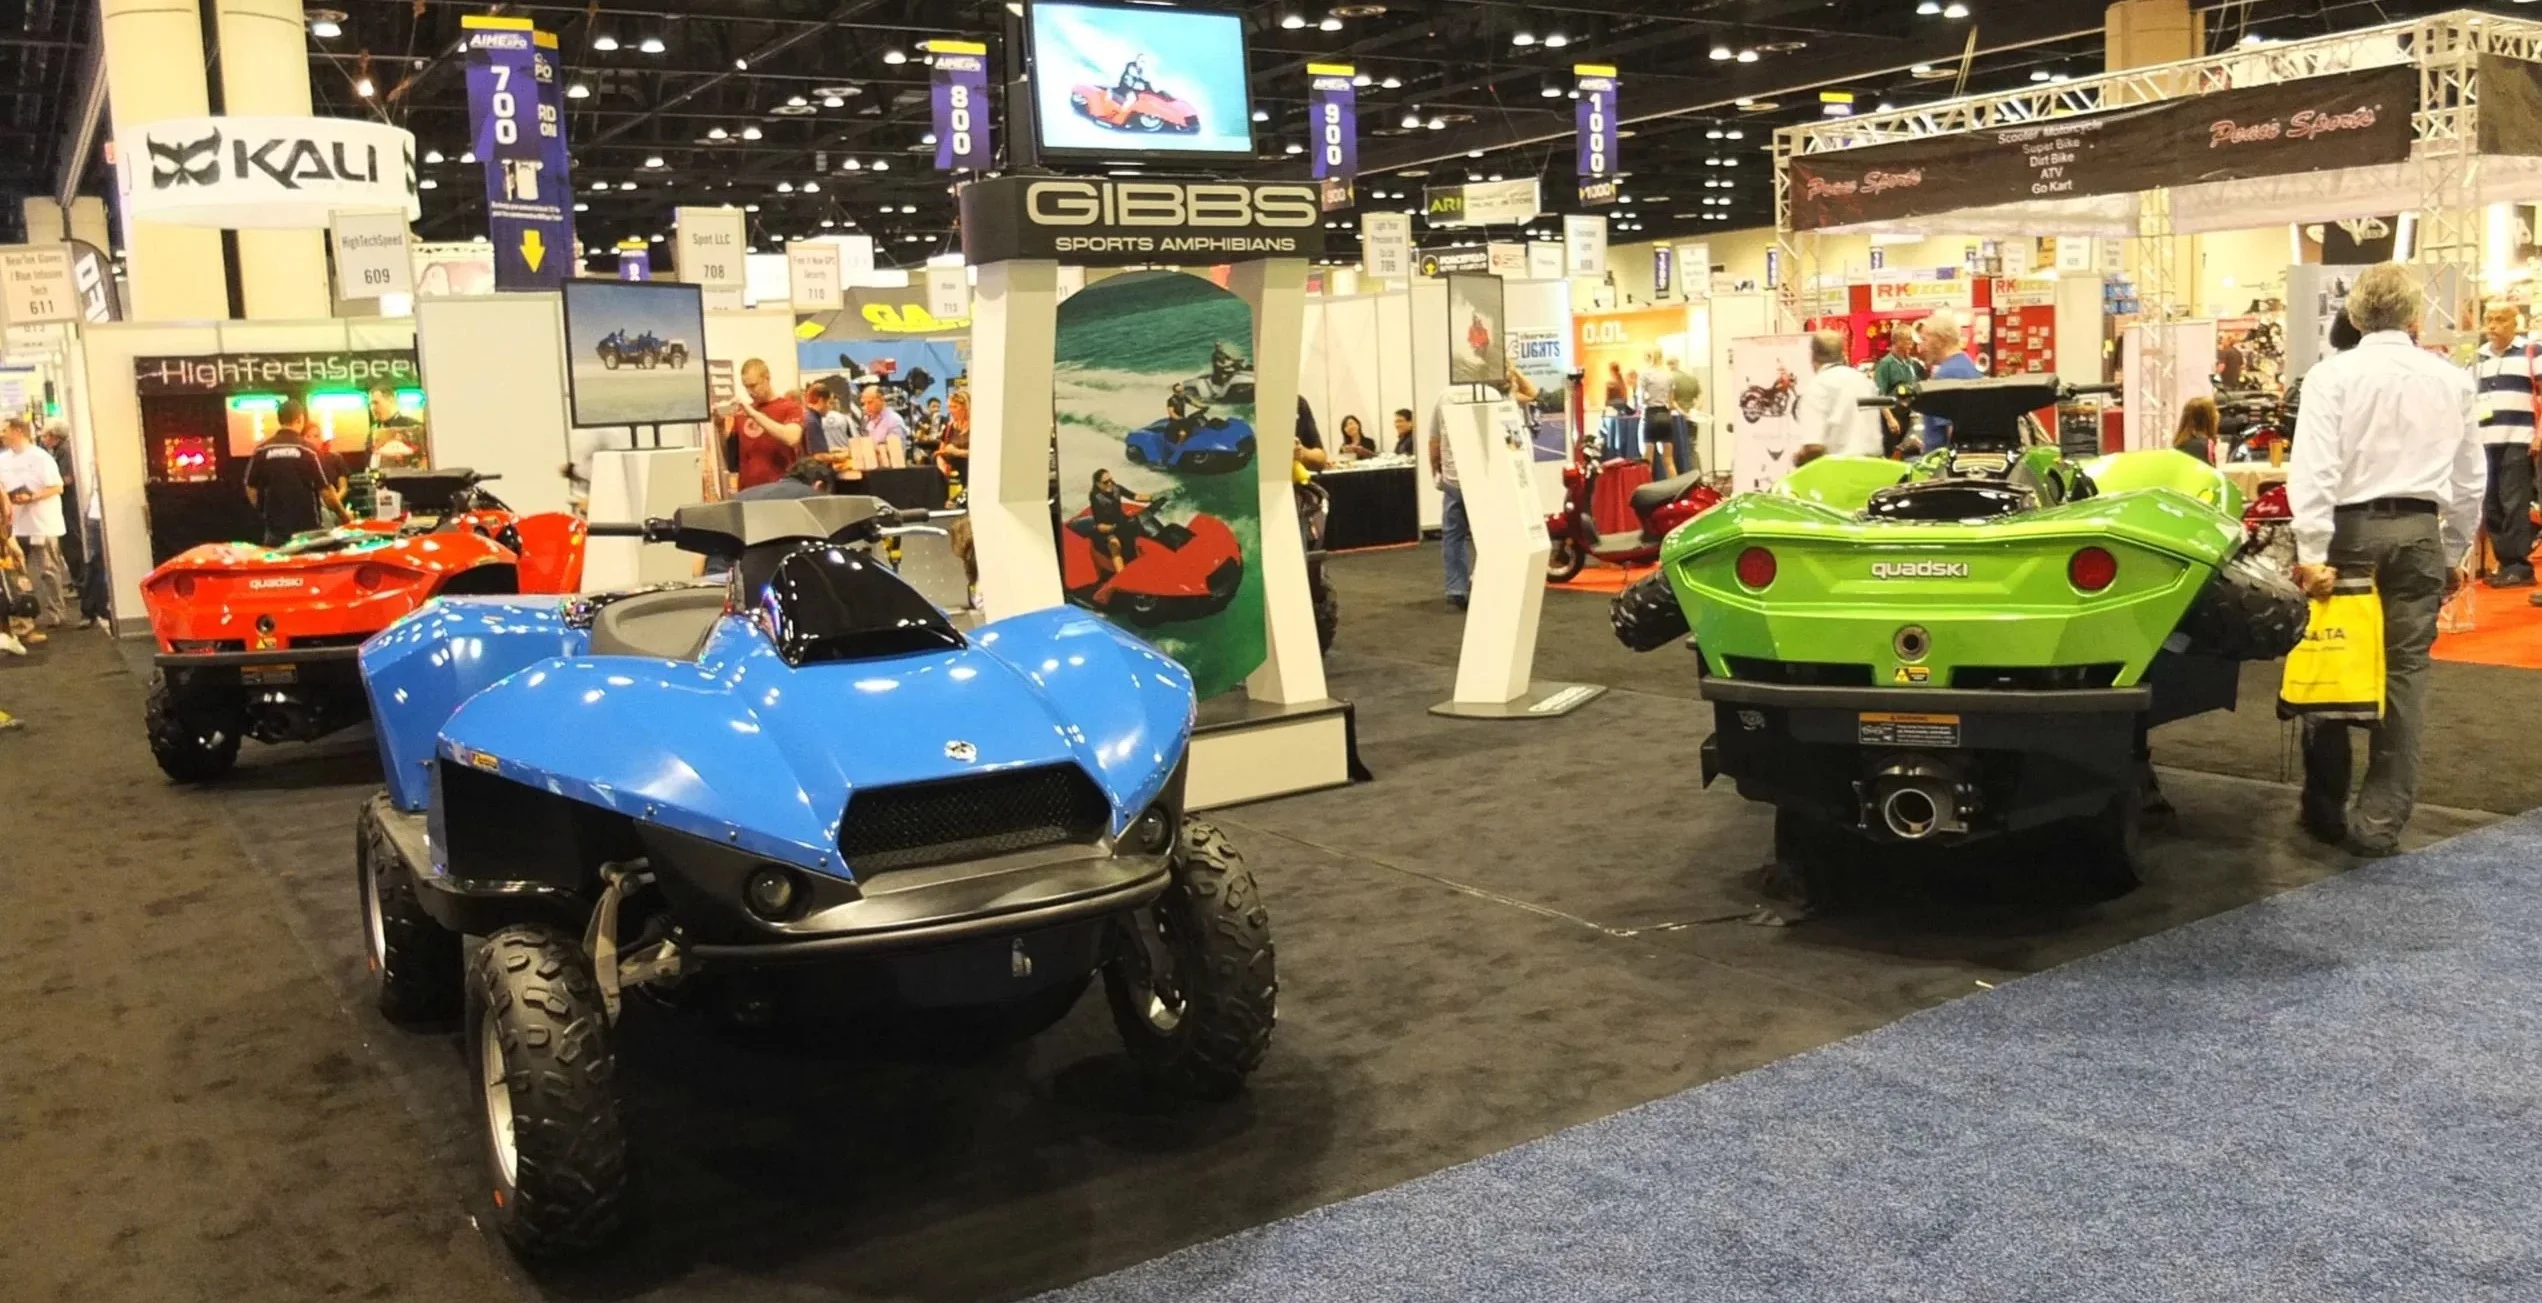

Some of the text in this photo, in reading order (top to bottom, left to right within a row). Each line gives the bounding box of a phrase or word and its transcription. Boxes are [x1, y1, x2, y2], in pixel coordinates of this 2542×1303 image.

[490, 65, 517, 145] 700
[951, 85, 971, 155] 800
[1325, 103, 1342, 166] 900
[1589, 92, 1604, 172] 1000
[1998, 129, 2039, 144] Scooter
[2022, 138, 2080, 155] Super Bike
[233, 139, 378, 189] KALI
[2029, 152, 2075, 167] Dirt Bike
[2040, 166, 2064, 179] ATV
[2031, 179, 2072, 194] Go Kart
[1026, 181, 1317, 227] GIBBS
[1430, 197, 1464, 214] ARI
[342, 235, 403, 251] HighTechSpeed
[692, 233, 731, 245] Spot LLC
[1055, 236, 1296, 252] SPORTS AMPHIBIANS
[364, 268, 391, 285] 609
[704, 265, 725, 279] 708
[30, 300, 54, 315] 611
[1521, 341, 1560, 359] LIGHTS
